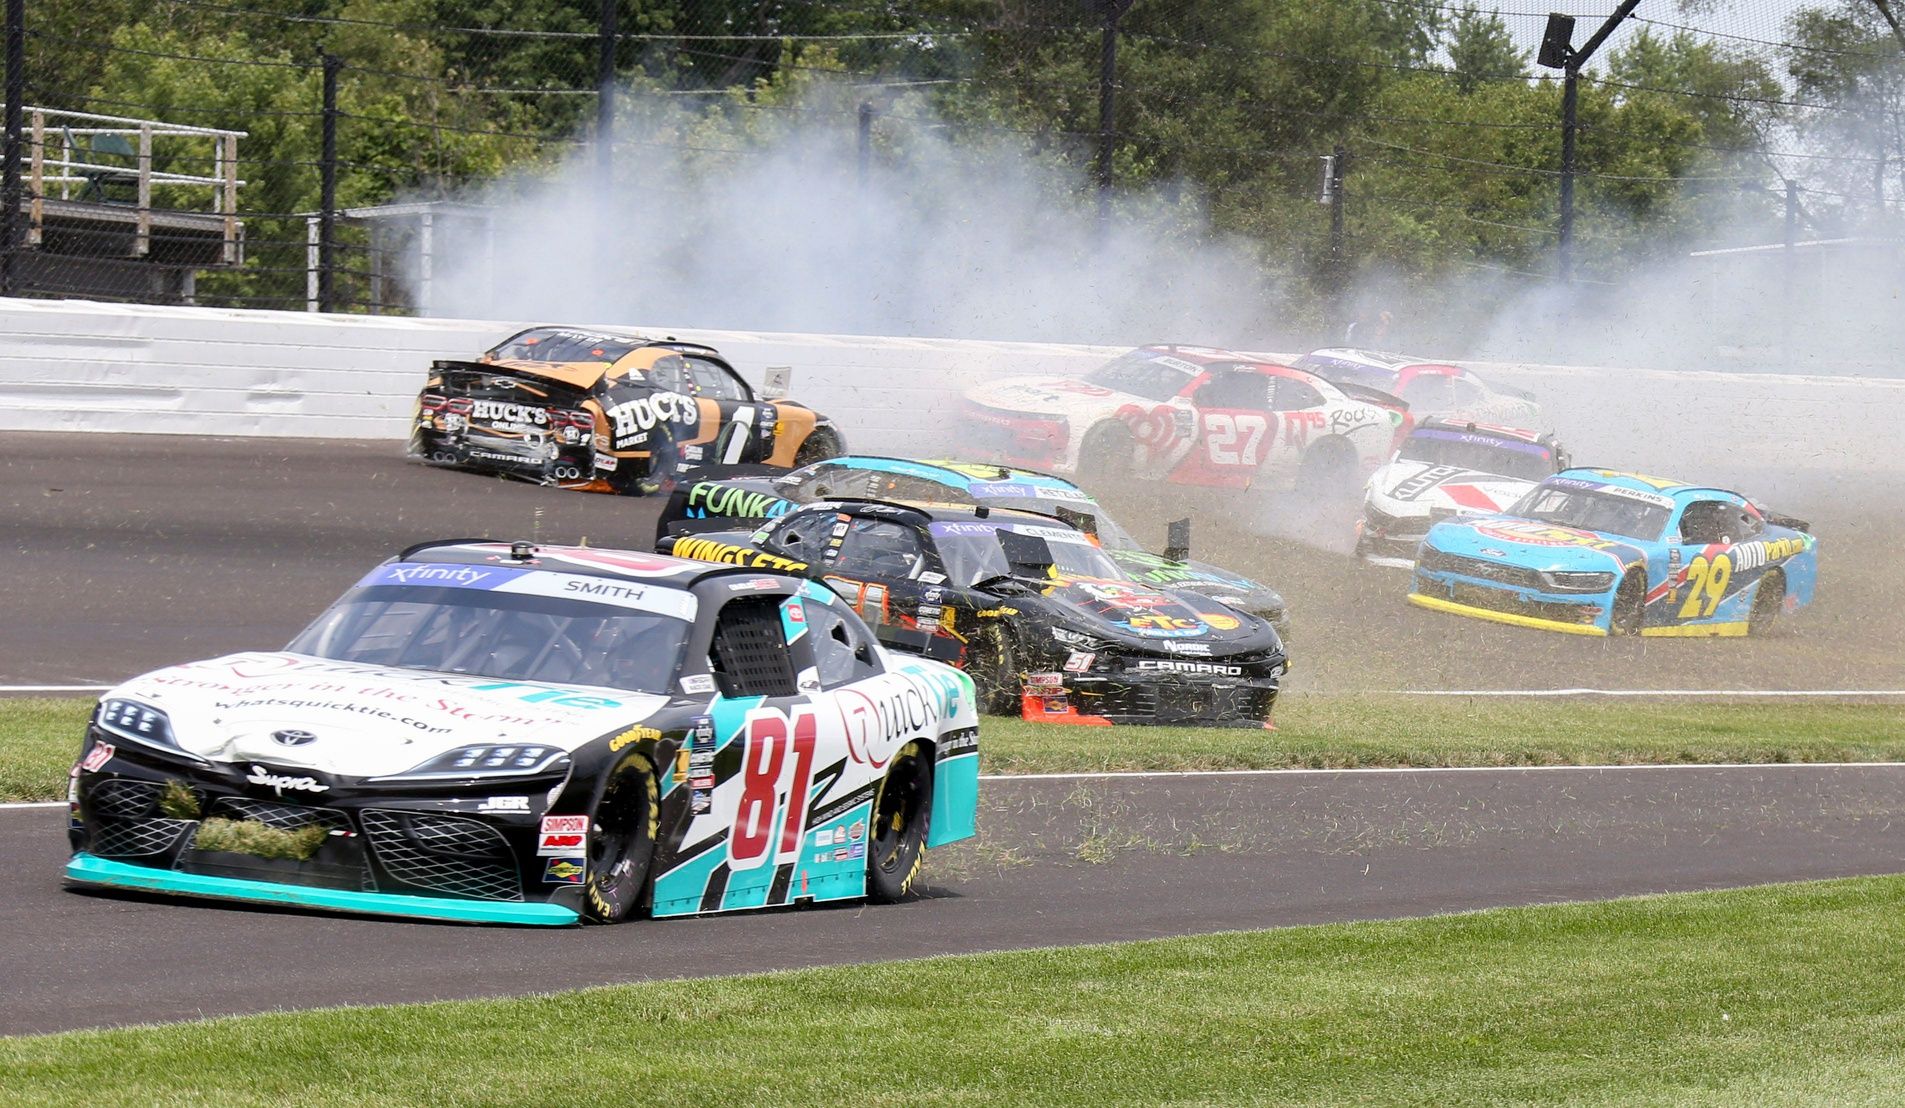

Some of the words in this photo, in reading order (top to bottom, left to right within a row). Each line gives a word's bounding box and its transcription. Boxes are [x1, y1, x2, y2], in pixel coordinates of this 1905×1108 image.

[472, 401, 548, 424] HUCK'S
[491, 421, 529, 433] ONLI
[722, 406, 755, 465] 1
[615, 432, 648, 449] MARKET
[1204, 414, 1268, 465] 27
[1460, 434, 1504, 447] xfinity
[469, 451, 544, 464] CAMARO
[983, 484, 1026, 496] xfinity
[1552, 478, 1594, 489] xfinity
[1613, 488, 1662, 502] PERKINS
[943, 523, 999, 535] xfinity
[673, 537, 755, 566] WINGS
[387, 566, 492, 585] xfinity
[564, 580, 645, 601] SMITH
[1677, 553, 1732, 619] 29
[1065, 653, 1094, 672] 51
[1138, 660, 1242, 676] CAMARO
[309, 681, 346, 693] in
[357, 687, 419, 702] the
[608, 724, 662, 752] GOODYEAR
[247, 765, 329, 797] Supra
[732, 713, 817, 861] 81
[544, 817, 584, 832] SIMPSON
